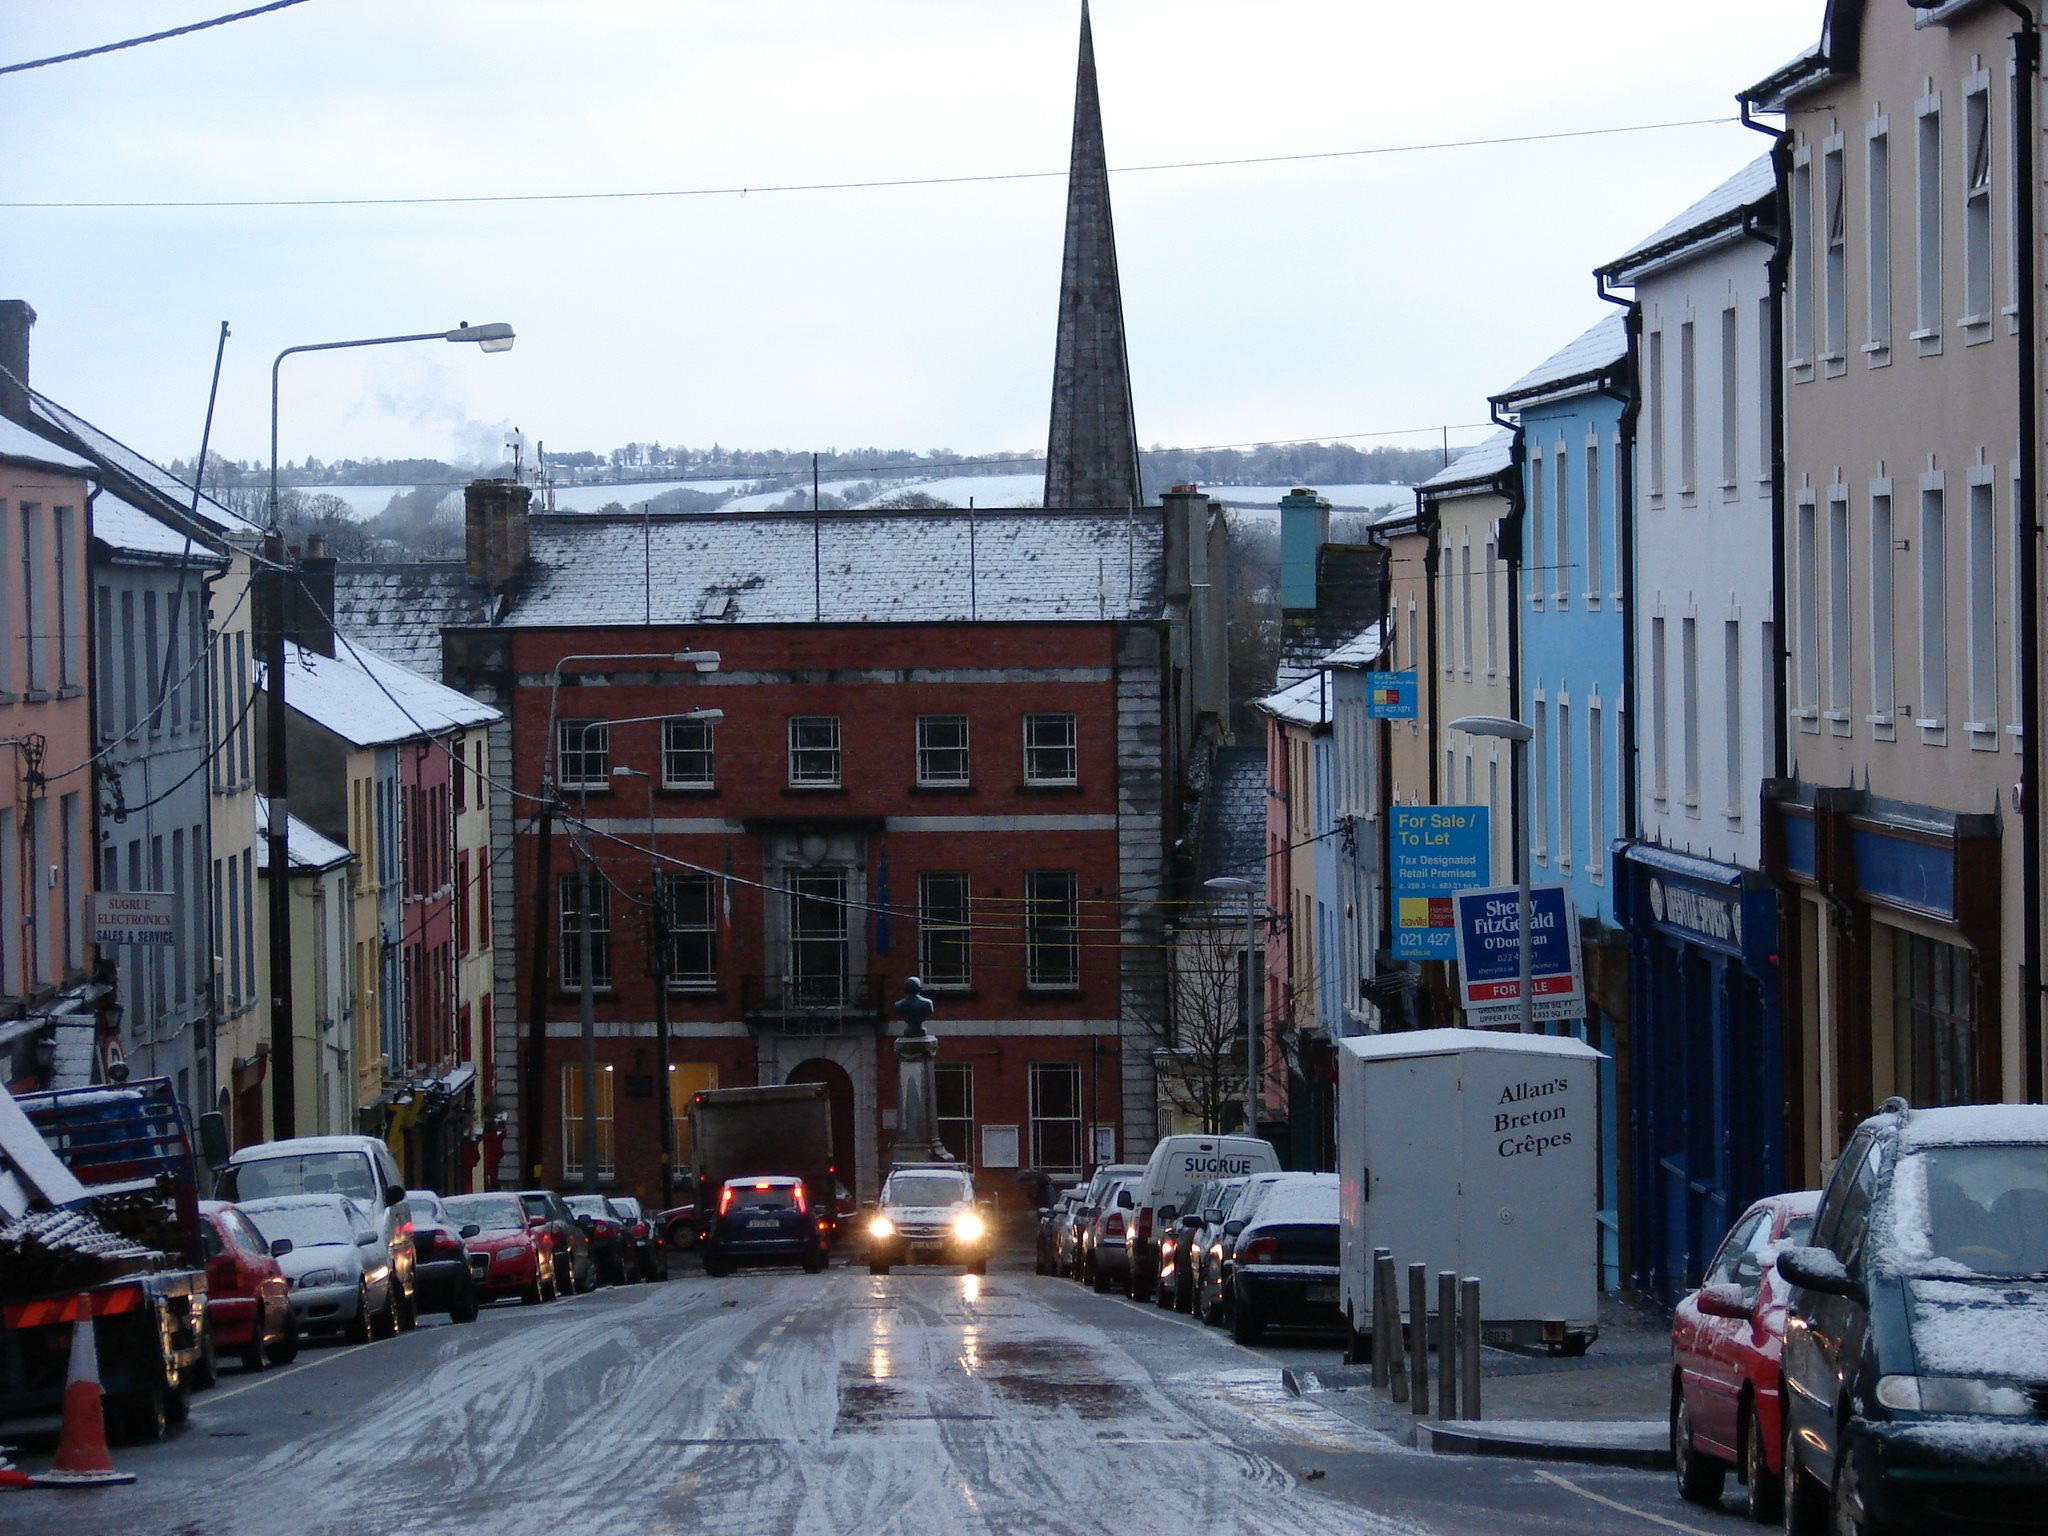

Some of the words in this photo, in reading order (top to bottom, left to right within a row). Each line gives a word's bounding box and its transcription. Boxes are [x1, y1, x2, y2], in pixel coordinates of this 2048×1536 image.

[1399, 814, 1425, 828] For
[1431, 813, 1465, 829] Sale
[1469, 813, 1476, 828] /
[1399, 831, 1420, 845] To
[1425, 831, 1451, 846] Let
[1398, 855, 1418, 865] Tax
[1420, 855, 1476, 867] Designated
[1399, 868, 1428, 878] Retail
[1431, 868, 1477, 878] Premises
[108, 898, 151, 910] SUGRUE
[97, 914, 171, 926] ELECTRONICS
[1401, 916, 1428, 926] savills
[1474, 911, 1555, 935] FitzGeald
[96, 930, 124, 942] SALES
[127, 931, 134, 942] &
[138, 931, 173, 944] SERVICE
[1400, 933, 1422, 946] 021
[1427, 933, 1452, 946] 427
[1492, 985, 1517, 997] FOR
[1530, 982, 1549, 994] LE
[1480, 1014, 1503, 1023] UPPER
[1498, 1078, 1568, 1105] Allan's
[1494, 1106, 1566, 1133] Breton
[1498, 1131, 1573, 1158] Crêpes
[1184, 1157, 1251, 1175] SUGRUE
